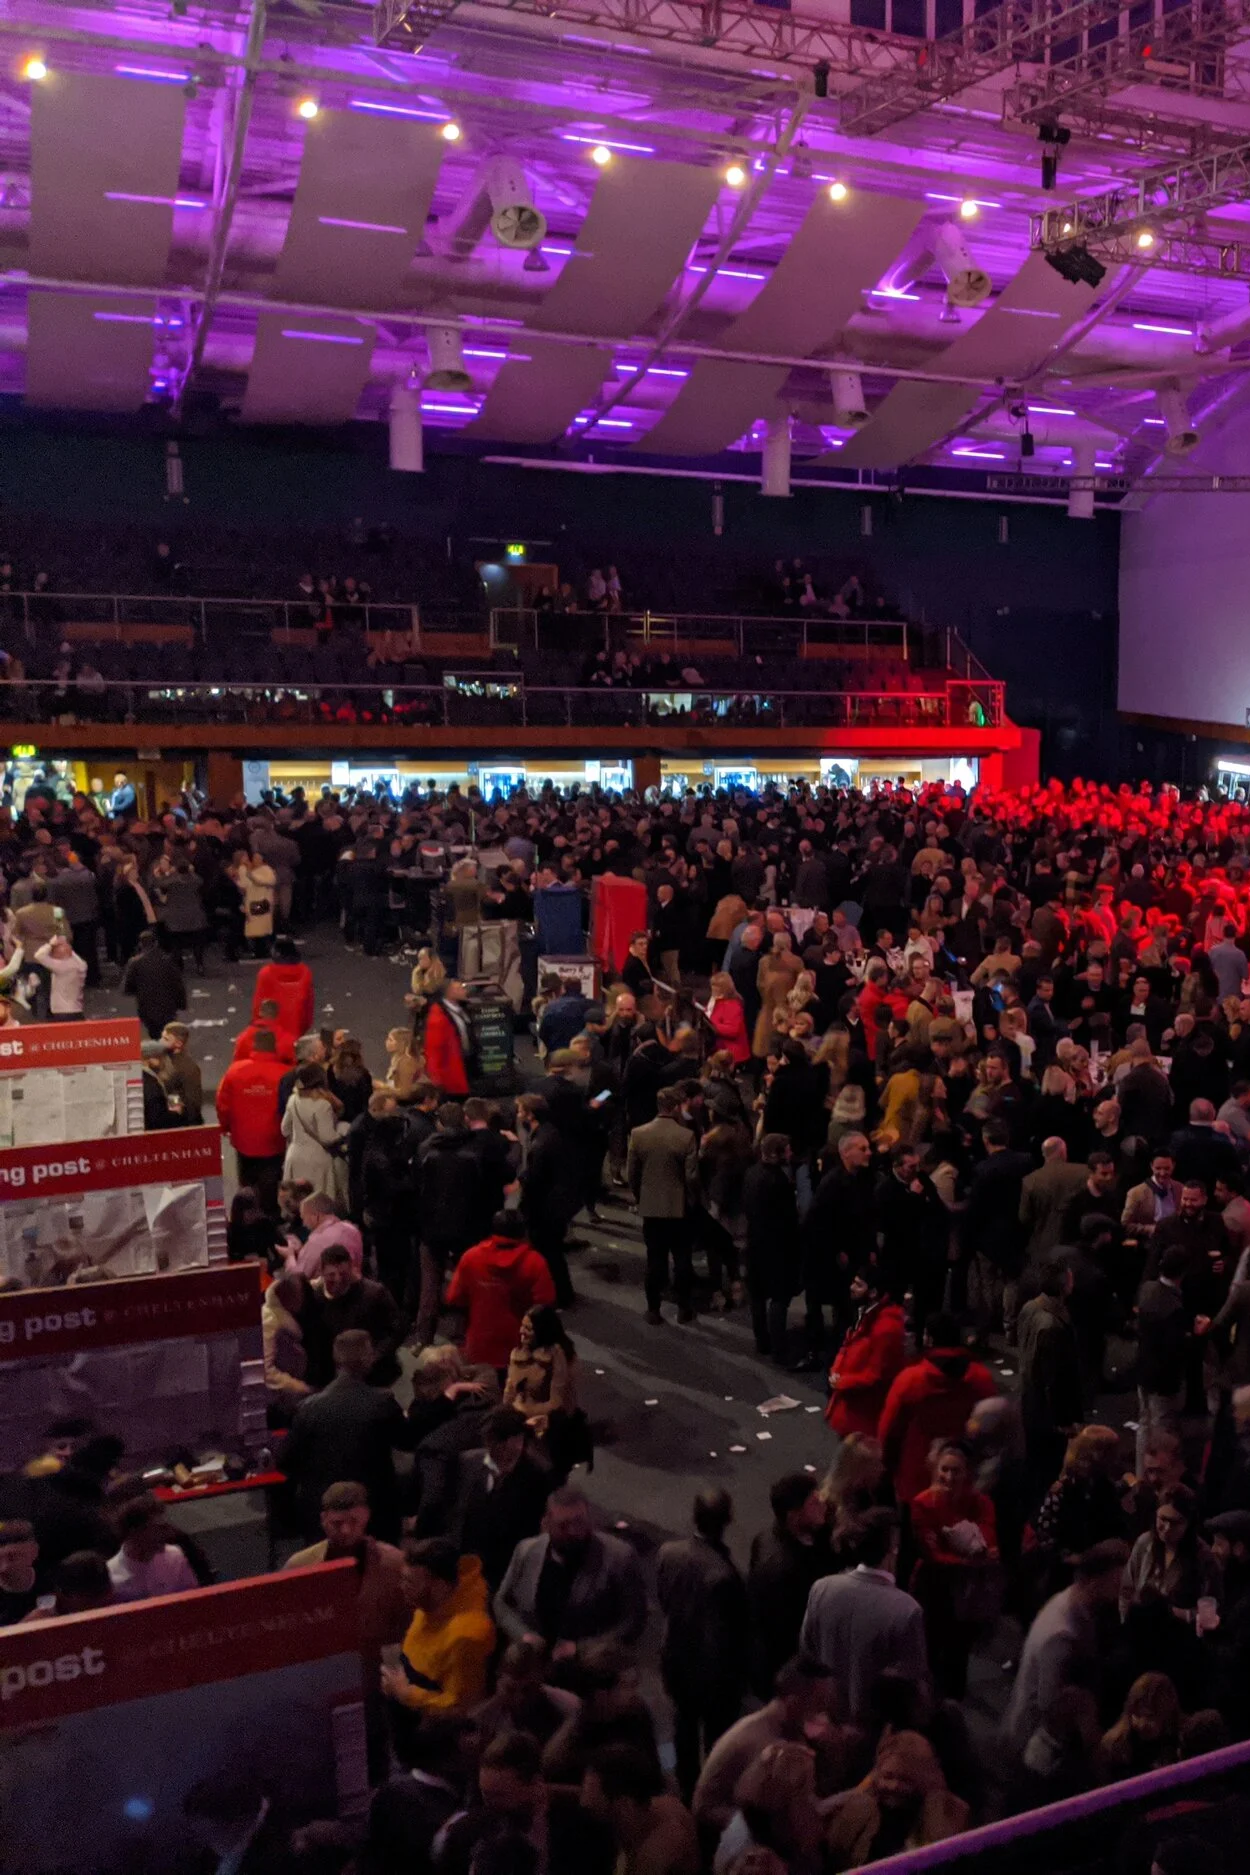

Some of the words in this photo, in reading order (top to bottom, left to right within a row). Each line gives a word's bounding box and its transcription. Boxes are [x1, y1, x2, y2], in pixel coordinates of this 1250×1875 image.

[43, 1036, 130, 1051] CHELTENHAM
[0, 1166, 25, 1186] ng
[33, 1157, 91, 1184] post
[112, 1147, 212, 1167] CHELTENHAM
[24, 1307, 97, 1341] post
[124, 1292, 250, 1317] CHELTENHAM
[0, 1646, 105, 1699] post
